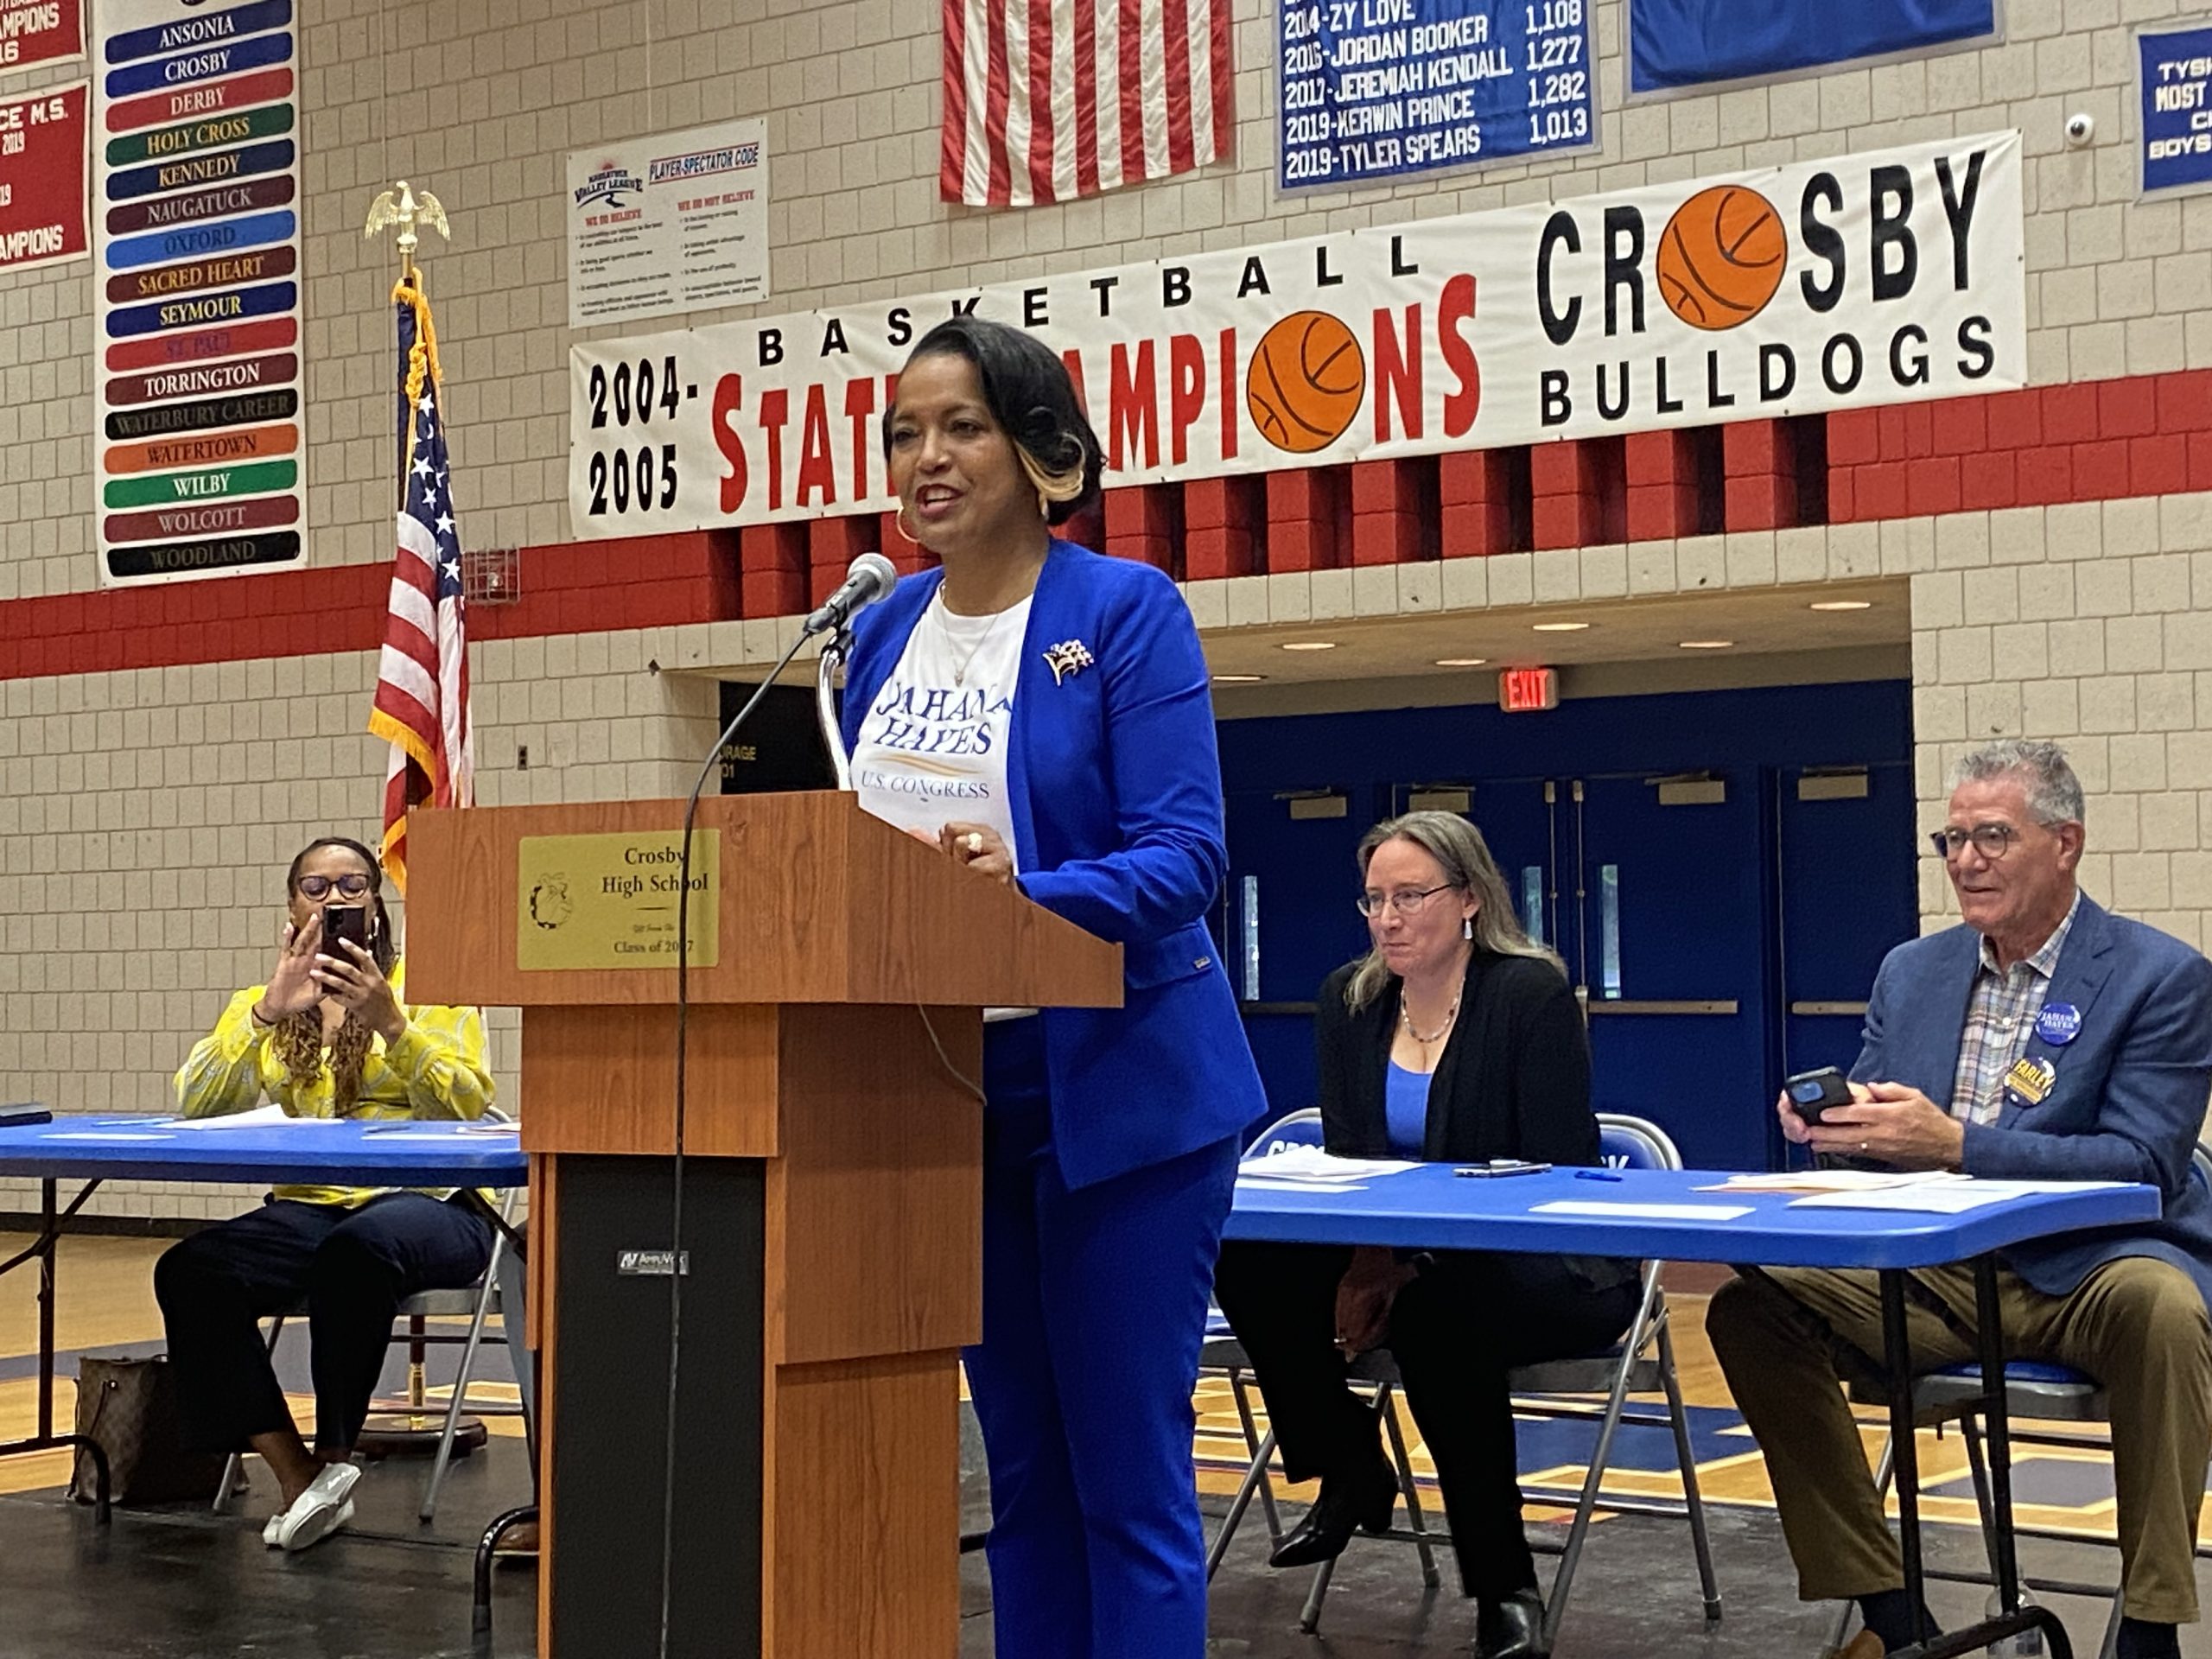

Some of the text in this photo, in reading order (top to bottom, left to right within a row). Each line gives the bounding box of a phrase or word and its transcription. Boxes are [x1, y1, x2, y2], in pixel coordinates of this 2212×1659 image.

[0, 3, 60, 40] MPIONS
[159, 16, 235, 48] ANSONIA
[1363, 0, 1415, 28] LOVE
[1525, 0, 1582, 35] 1,108
[1411, 15, 1488, 55] BOOKER
[1526, 35, 1583, 72] 1,277
[164, 50, 231, 81] CROSBY
[1427, 48, 1514, 89] KENDALL
[1528, 71, 1586, 108] 1,282
[30, 98, 68, 125] M.S.
[170, 86, 226, 115] DERBY
[2155, 81, 2207, 112] MOST
[1408, 89, 1476, 127] PRINCE
[1529, 107, 1587, 144] 1,013
[2, 130, 25, 156] 2019
[147, 118, 251, 156] HOLY CROSS
[1406, 125, 1481, 162] SPEARS
[2149, 134, 2212, 160] BOYS
[158, 154, 241, 188] KENNEDY
[147, 188, 252, 224] NAUGATUCK
[164, 227, 236, 255] OXFORD
[138, 256, 264, 295] SACRED HEART
[160, 295, 242, 326] SEYMOUR
[759, 236, 1419, 366] BASKETBALL
[144, 363, 260, 397] TORRINGTON
[1541, 315, 1995, 427] BULLDOGS
[116, 395, 289, 435] WATERBURY CAREER
[147, 435, 257, 464] WATERTOWN
[173, 474, 231, 497] WILBY
[589, 443, 677, 516] 2005
[158, 506, 246, 533] WOLCOTT
[149, 541, 256, 569] WOODLAND
[1507, 671, 1548, 709] EXIT
[874, 718, 991, 754] HAYES
[890, 777, 990, 799] CONGRESS
[602, 873, 709, 898] High Schol
[614, 940, 694, 954] Class of 207
